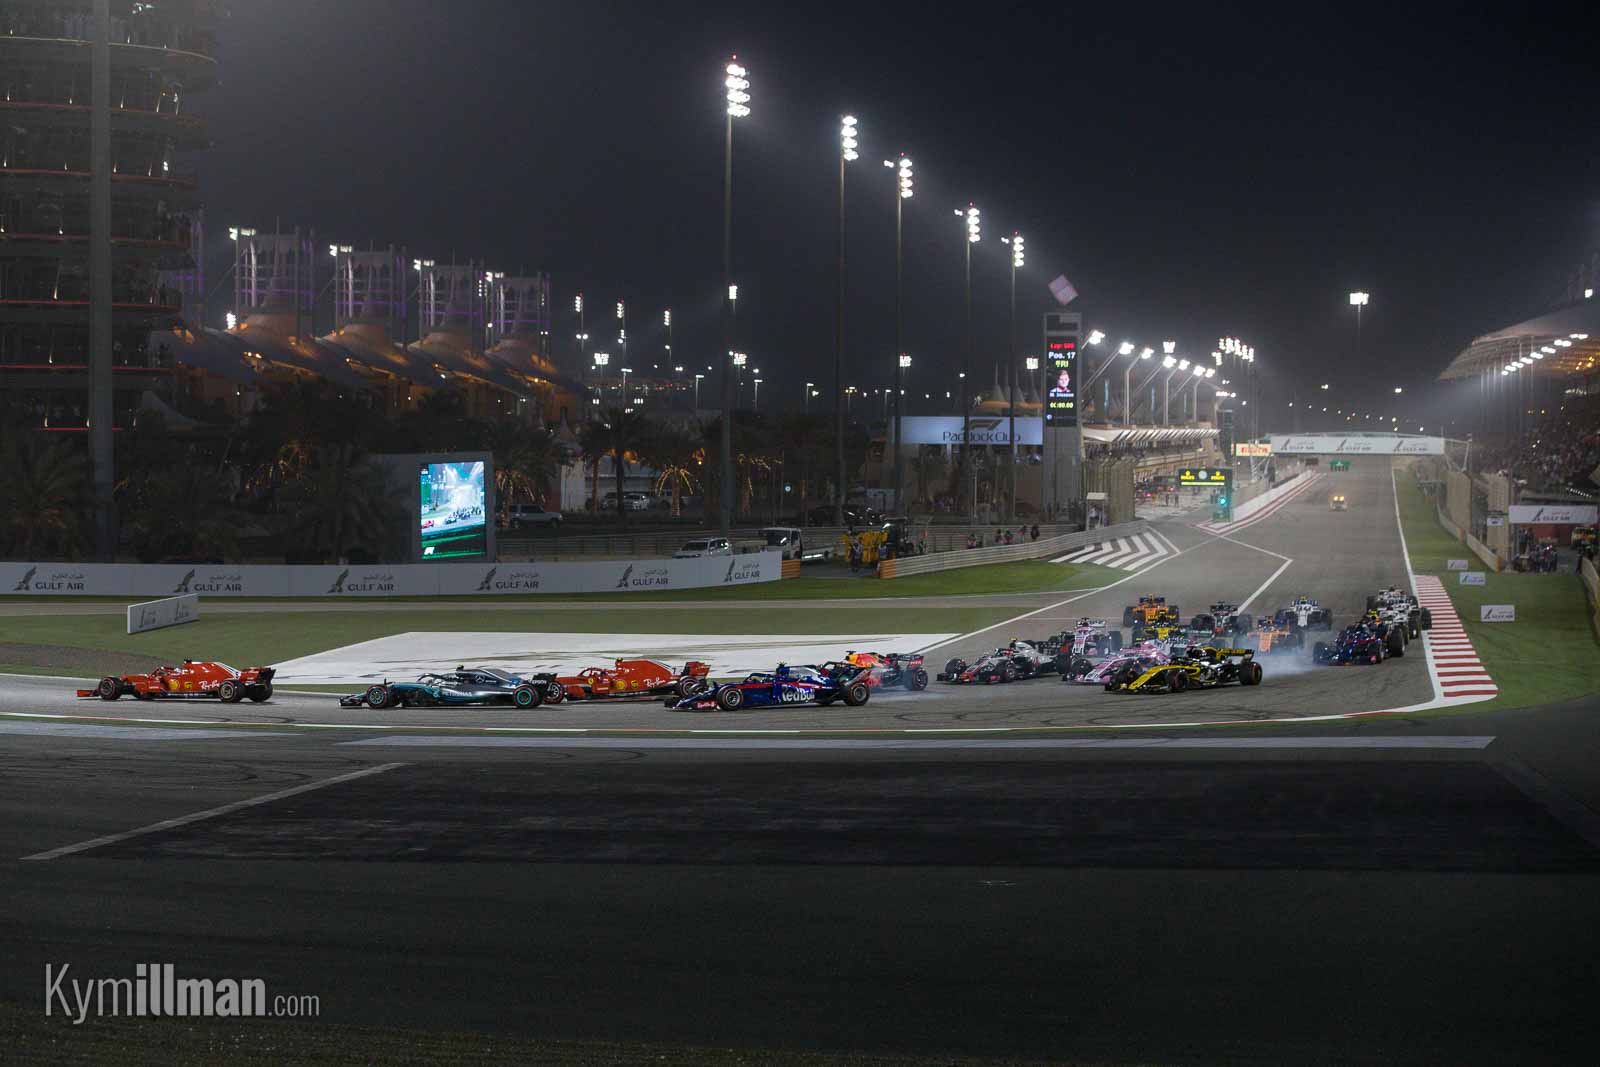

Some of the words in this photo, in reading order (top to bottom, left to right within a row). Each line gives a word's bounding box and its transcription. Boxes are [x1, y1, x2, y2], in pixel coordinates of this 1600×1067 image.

[943, 431, 994, 441] Padock
[734, 572, 750, 580] GULF
[750, 570, 760, 578] AIR
[495, 581, 521, 589] GULF
[523, 581, 539, 589] AIR
[632, 578, 654, 586] GULF
[655, 577, 669, 585] AIR
[35, 582, 64, 591] GULF
[67, 582, 85, 591] AIR
[194, 583, 220, 592] GULF
[223, 583, 242, 592] AIR
[347, 583, 375, 592] GULF
[376, 583, 394, 592] AIR
